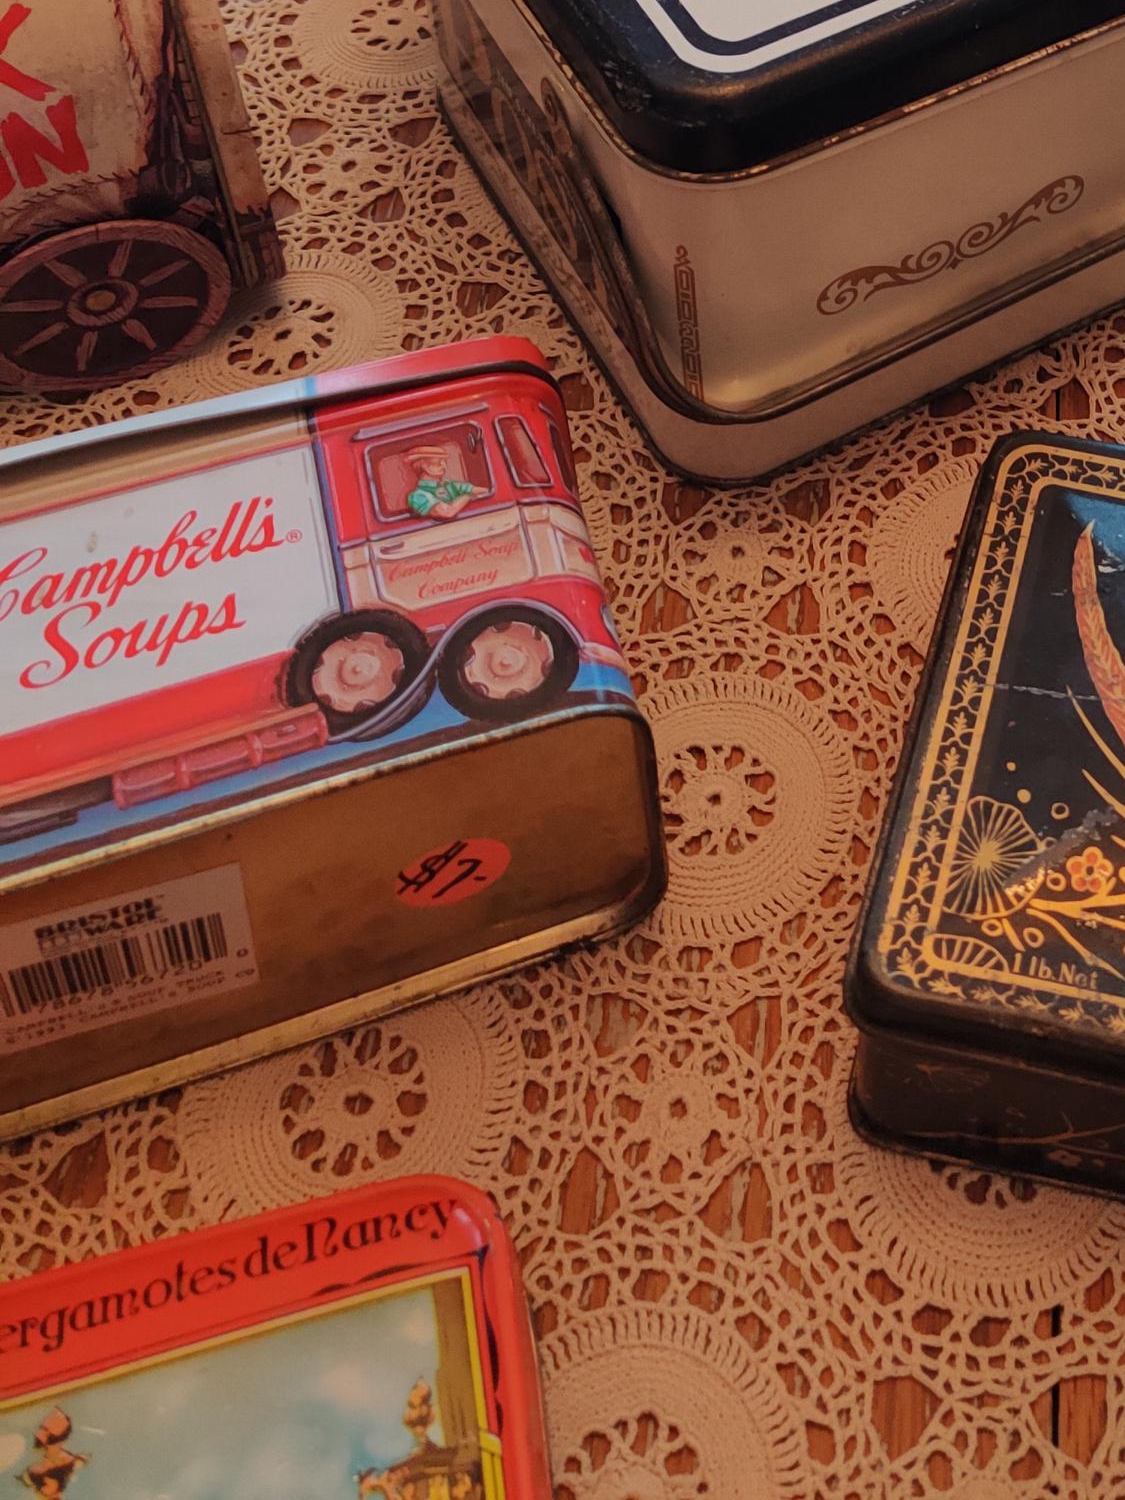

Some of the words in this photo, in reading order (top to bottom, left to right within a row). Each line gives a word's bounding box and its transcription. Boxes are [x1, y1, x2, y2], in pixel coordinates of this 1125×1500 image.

[387, 550, 466, 582] Campbell
[417, 568, 499, 600] Company
[19, 593, 247, 689] Soups
[1060, 963, 1099, 989] Net
[0, 1255, 237, 1356] ergamotes
